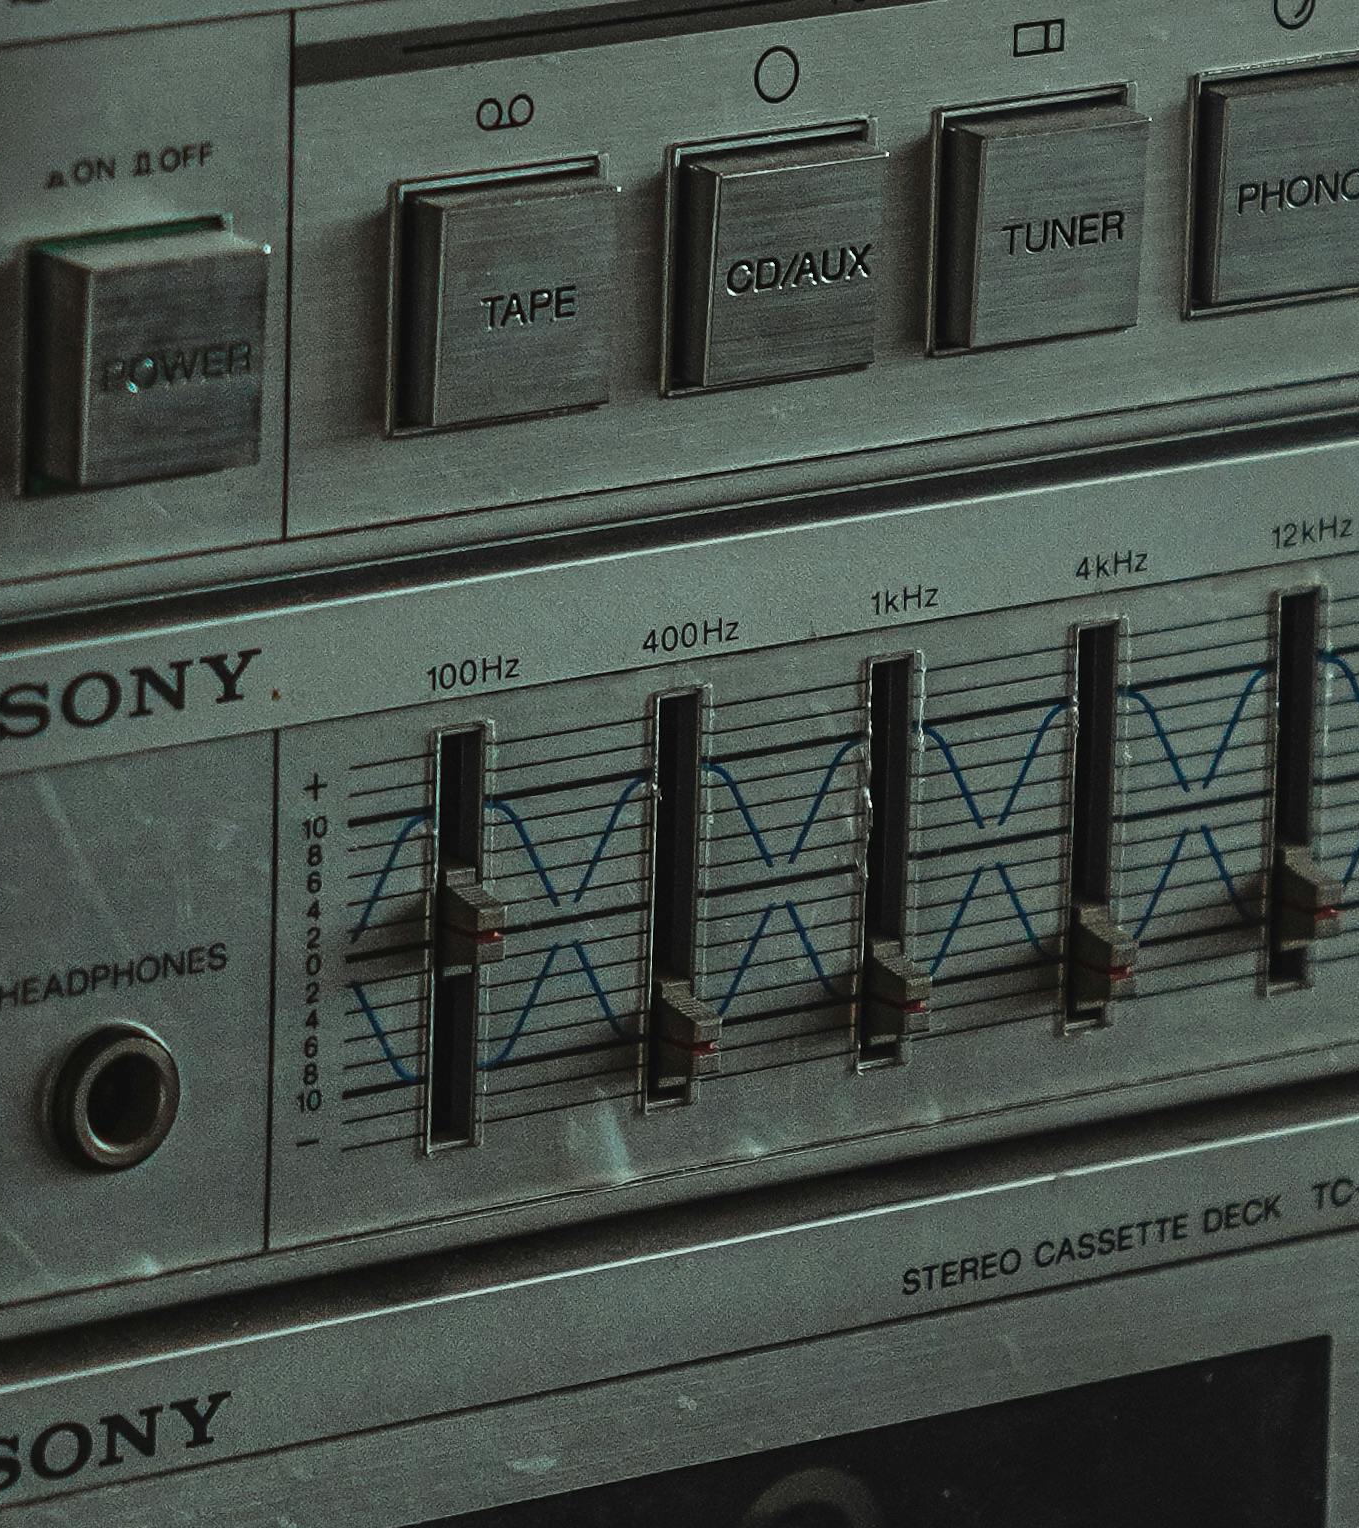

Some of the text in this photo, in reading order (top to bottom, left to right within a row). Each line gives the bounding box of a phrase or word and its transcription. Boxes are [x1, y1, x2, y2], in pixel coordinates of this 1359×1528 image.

[73, 142, 214, 184] ON OFF
[1002, 210, 1124, 255] TUNER
[726, 244, 872, 296] CD/AUX
[480, 286, 576, 330] TAPE
[100, 343, 251, 392] POWER
[1272, 514, 1354, 549] 12kHz
[1076, 550, 1149, 582] 4kHz
[871, 583, 939, 616] 1kHz
[643, 617, 740, 655] 400Hz
[427, 655, 521, 690] 100Hz
[902, 1248, 1022, 1296] STEREO
[1035, 1215, 1188, 1267] CASSETTE
[1204, 1194, 1281, 1234] DECK
